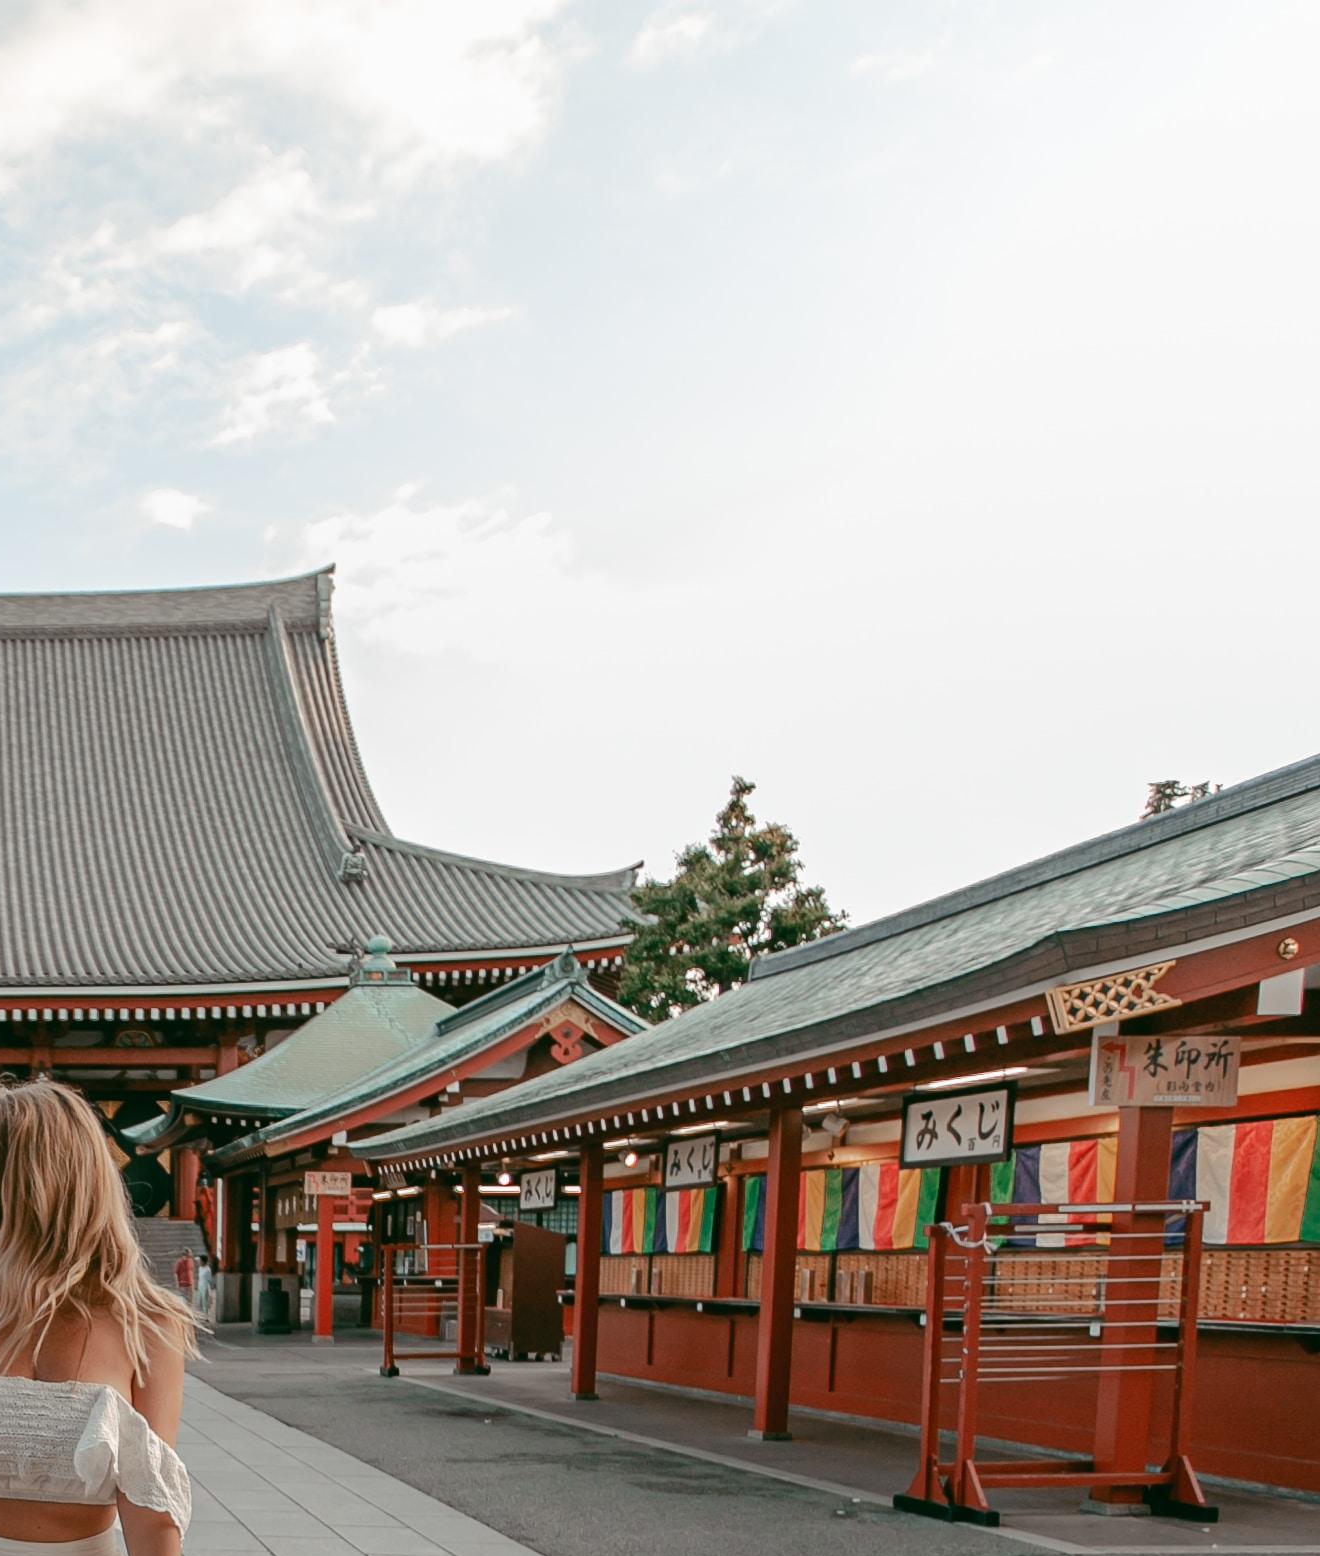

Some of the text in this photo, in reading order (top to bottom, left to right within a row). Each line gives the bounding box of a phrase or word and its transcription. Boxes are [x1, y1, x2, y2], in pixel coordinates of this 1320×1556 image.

[1143, 1038, 1234, 1079] 朱印所
[917, 1100, 1000, 1151] みくじ
[670, 1141, 714, 1176] みくじ
